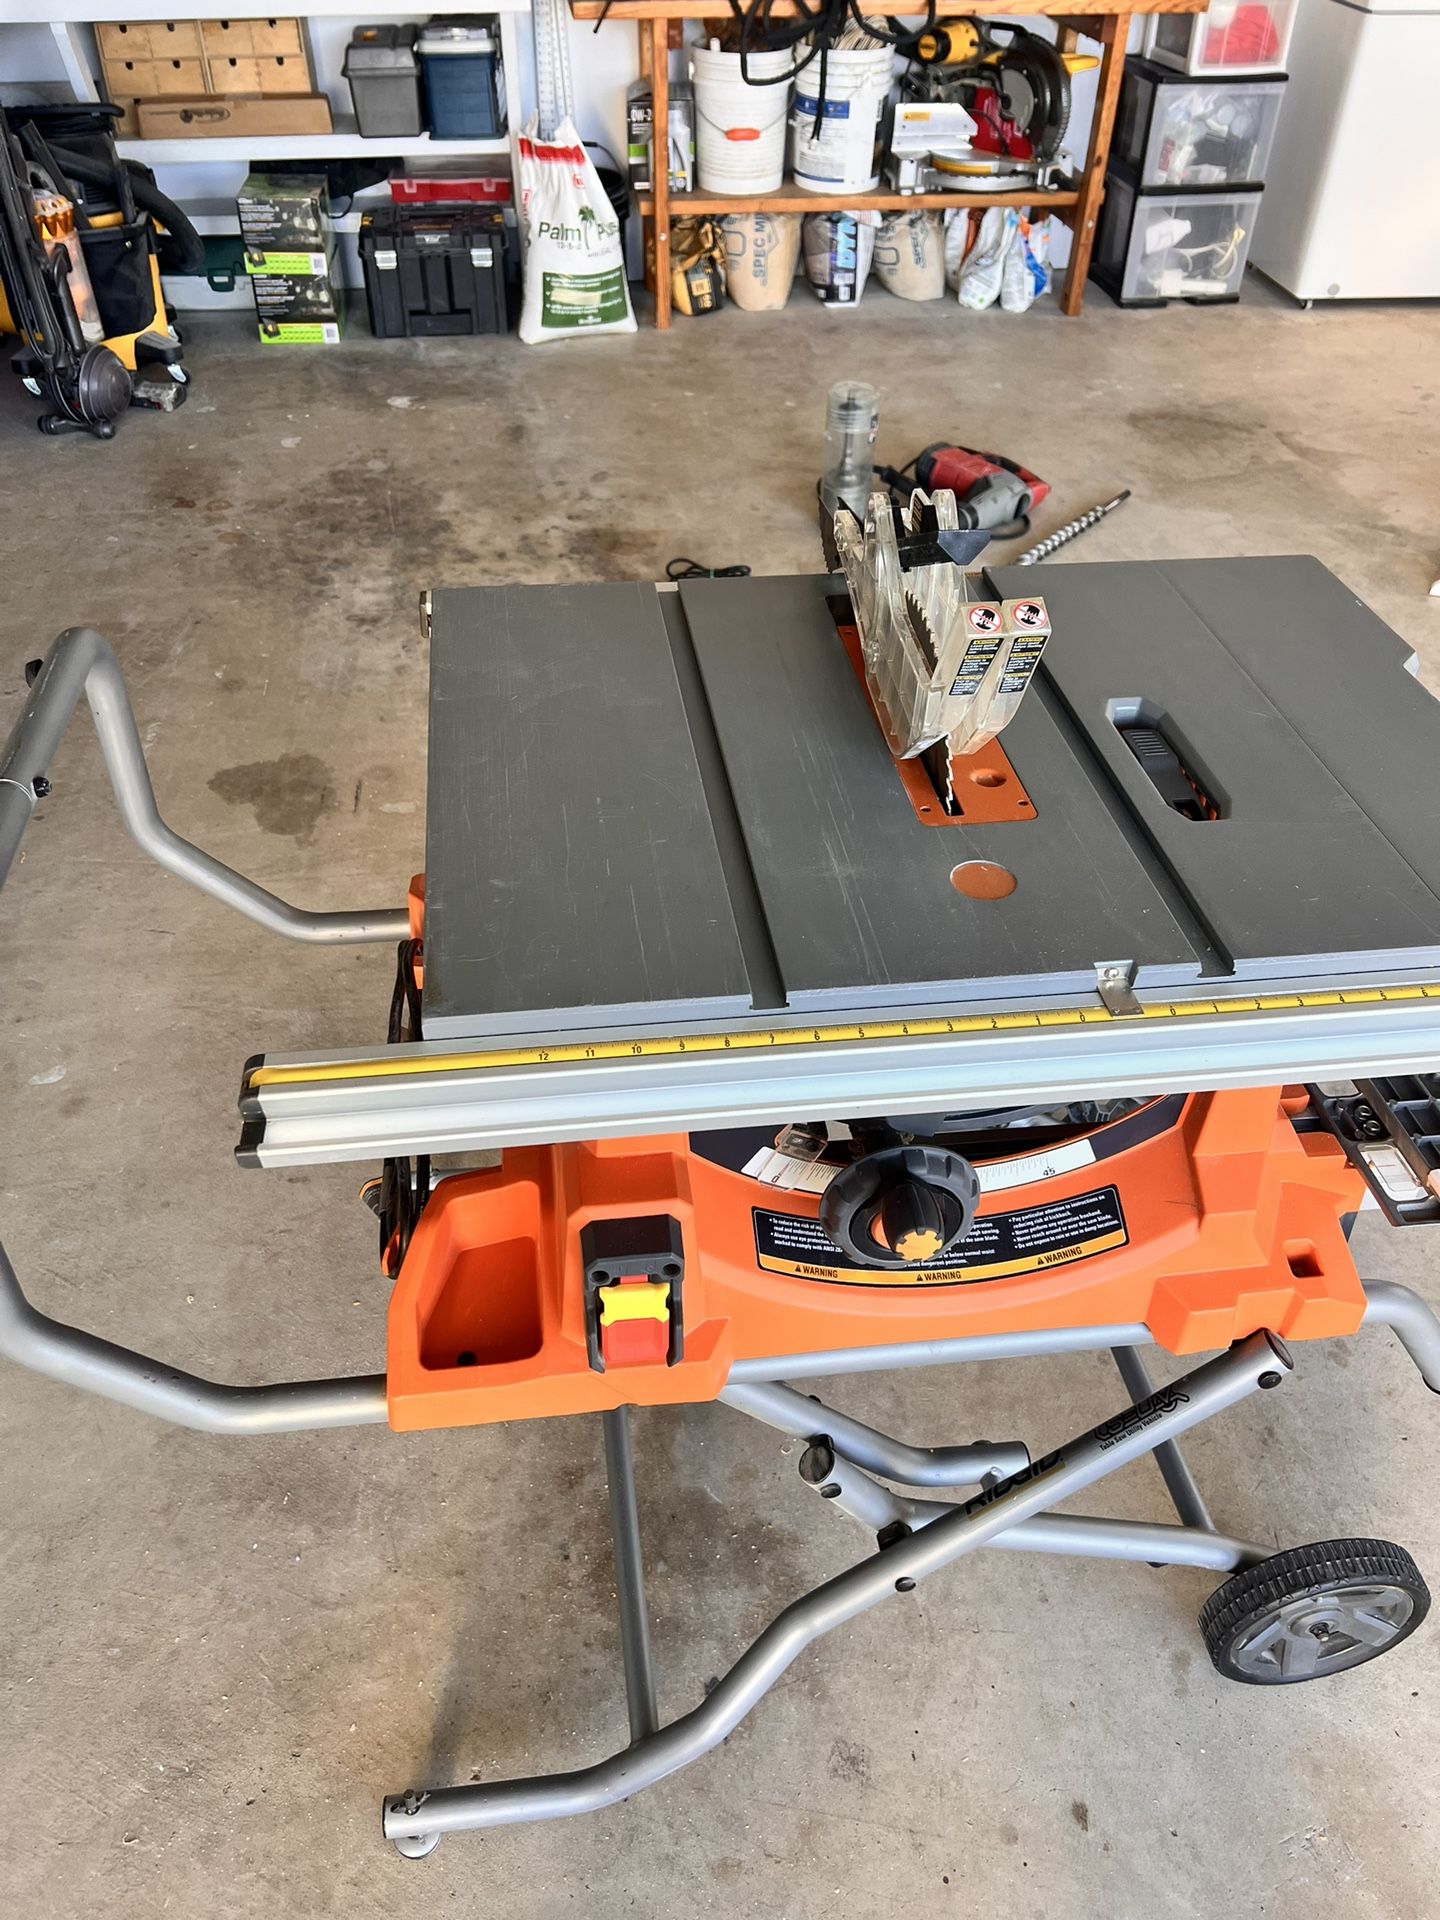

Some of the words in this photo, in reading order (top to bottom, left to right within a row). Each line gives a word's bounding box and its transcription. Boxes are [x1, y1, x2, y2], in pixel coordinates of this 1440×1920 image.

[538, 221, 580, 241] Palm
[753, 214, 766, 233] MI
[836, 217, 857, 269] DYN
[752, 237, 765, 278] SPEC
[1170, 1007, 1177, 1016] 0
[1213, 1005, 1218, 1013] 1
[1256, 1002, 1262, 1010] 2
[1298, 998, 1304, 1007] 3
[1339, 995, 1345, 1004] 4
[1381, 992, 1387, 1000] 5
[1422, 989, 1428, 998] 6
[538, 1052, 549, 1061] 12
[585, 1048, 595, 1057] 11
[631, 1045, 642, 1054] 10
[679, 1041, 685, 1051] 9
[725, 1038, 730, 1048] 8
[770, 1036, 775, 1045] 7
[814, 1031, 820, 1041] 6
[859, 1029, 865, 1038] 5
[903, 1026, 909, 1035] 4
[948, 1023, 953, 1032] 3
[992, 1020, 998, 1029] 2
[1036, 1017, 1041, 1026] 1
[1080, 1014, 1086, 1023] 0
[772, 1175, 779, 1183] 0
[1043, 1167, 1056, 1176] 45
[1022, 1211, 1044, 1220] particular
[1045, 1206, 1065, 1214] attention
[1071, 1197, 1098, 1207] instructions
[1013, 1220, 1034, 1230] reducing
[1030, 1224, 1048, 1233] perform
[1057, 1216, 1079, 1225] operation
[921, 1260, 945, 1268] dangerous
[1043, 1247, 1083, 1265] WARNING
[802, 1265, 838, 1279] WARNING
[924, 1271, 961, 1281] WARNING
[1100, 1441, 1114, 1451] Table
[1114, 1434, 1127, 1443] Saw
[1126, 1424, 1143, 1436] Utility
[1142, 1412, 1163, 1427] Vehicle
